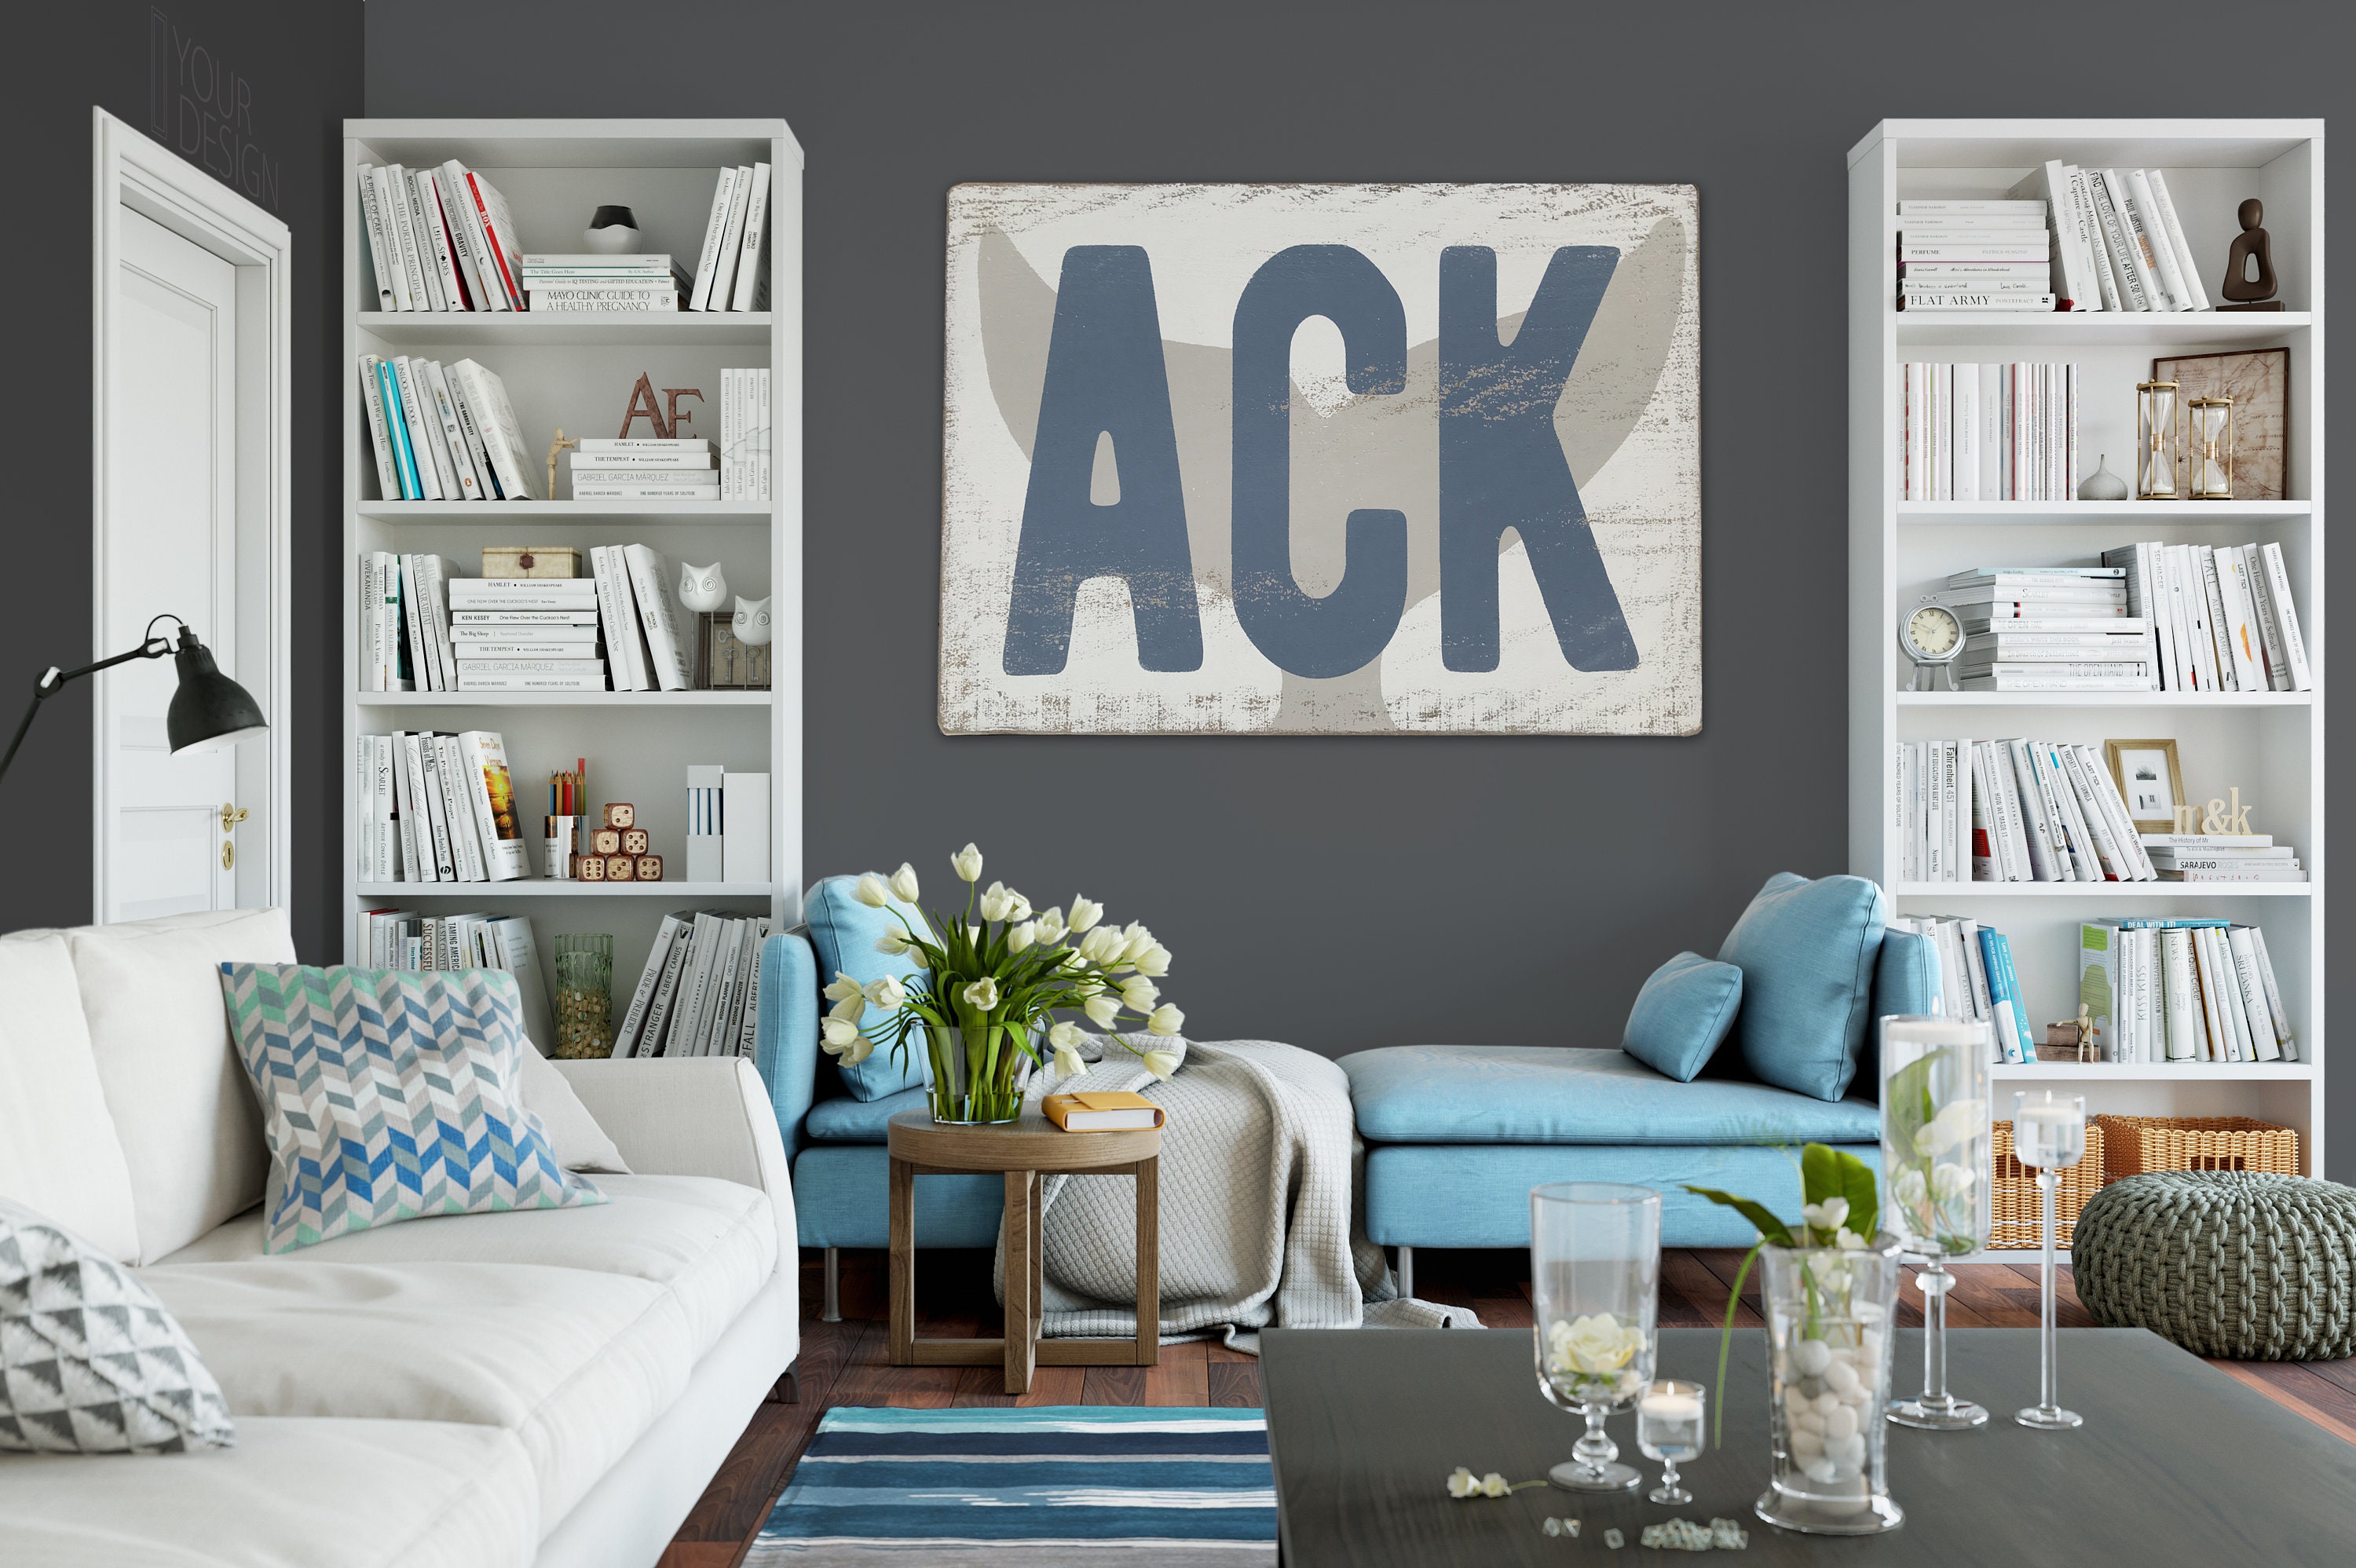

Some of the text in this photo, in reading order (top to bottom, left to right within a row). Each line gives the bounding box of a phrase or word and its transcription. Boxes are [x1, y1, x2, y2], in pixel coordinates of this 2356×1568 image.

[367, 182, 376, 203] PIECE
[371, 203, 379, 213] OF
[479, 209, 492, 228] BOX
[2068, 178, 2083, 210] Capture
[2078, 220, 2088, 243] Castle
[373, 213, 382, 236] CAKE
[407, 175, 415, 196] SOCIAL
[422, 242, 432, 272] EDUCATION
[444, 198, 468, 257] OVERCOMING GRAVITY
[2086, 210, 2095, 233] Magic
[2090, 172, 2137, 284] FIND THE LOVE OF YOUR LIFE AFTER
[2093, 238, 2100, 247] IN
[2124, 199, 2153, 270] PAUL AUSTER SUNSET PARK
[397, 201, 423, 302] THE PORTER PRINCIPLES
[2096, 250, 2110, 283] MIDLIFE
[547, 291, 650, 300] MAYO CLINIC GUIDE TO
[547, 302, 650, 311] A HEALTHY PREGNANCY
[1911, 295, 1945, 305] FLAT
[1949, 295, 1991, 305] ARMY
[397, 363, 417, 427] UNLOCK THE DOOR
[1002, 244, 1641, 679] ACK
[2154, 550, 2164, 589] SER+HACER
[2253, 571, 2266, 598] Hundred
[2204, 558, 2228, 657] FALL ALBERT CAMUS
[2258, 598, 2270, 616] Years
[2266, 626, 2277, 650] Solitude
[2069, 664, 2124, 676] THE OPEN HAND
[421, 736, 434, 753] Fossils
[425, 758, 436, 773] Malta
[2064, 750, 2076, 769] PROPERTY
[2080, 784, 2092, 802] FORMULA
[2085, 762, 2094, 774] LAST
[378, 766, 389, 795] SCARLET
[2115, 800, 2128, 824] Veronica
[2133, 839, 2142, 855] Wells
[448, 923, 457, 945] TAMING
[2170, 936, 2179, 961] NEWS
[2219, 942, 2228, 959] Tales
[2188, 956, 2197, 975] Quite
[642, 968, 657, 988] PRIDE
[2191, 976, 2201, 1000] Cricket
[2236, 955, 2253, 1003] SRI LANKA
[641, 946, 682, 1053] STRANGER ALBERT CAMUS
[2137, 965, 2146, 1020] KISS KISS
[624, 999, 645, 1035] PREJUDICE
